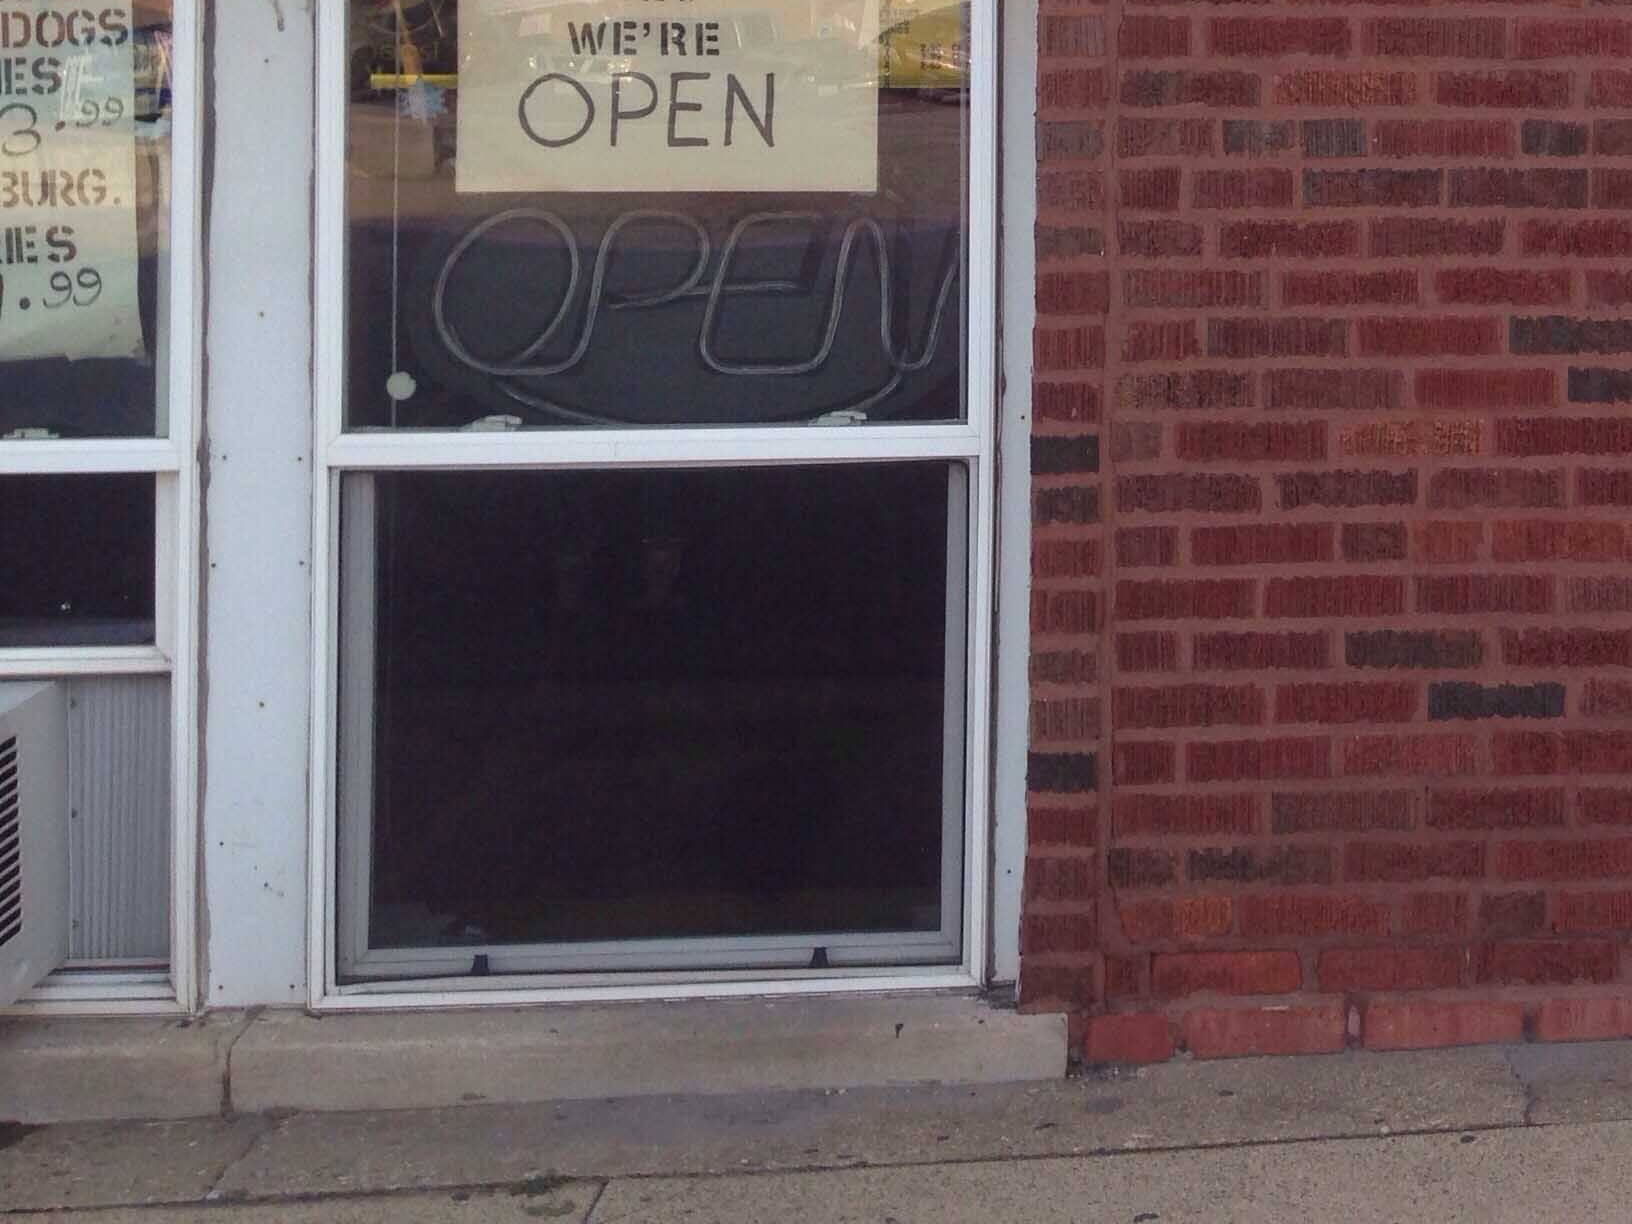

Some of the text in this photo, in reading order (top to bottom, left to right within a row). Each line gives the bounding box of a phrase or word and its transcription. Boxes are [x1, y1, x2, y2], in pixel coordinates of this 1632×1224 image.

[0, 8, 129, 48] DOGS
[568, 20, 720, 56] WE'RE
[0, 57, 62, 95] ES
[518, 73, 775, 148] OPEN
[0, 226, 77, 264] IES
[434, 208, 960, 376] OPEN
